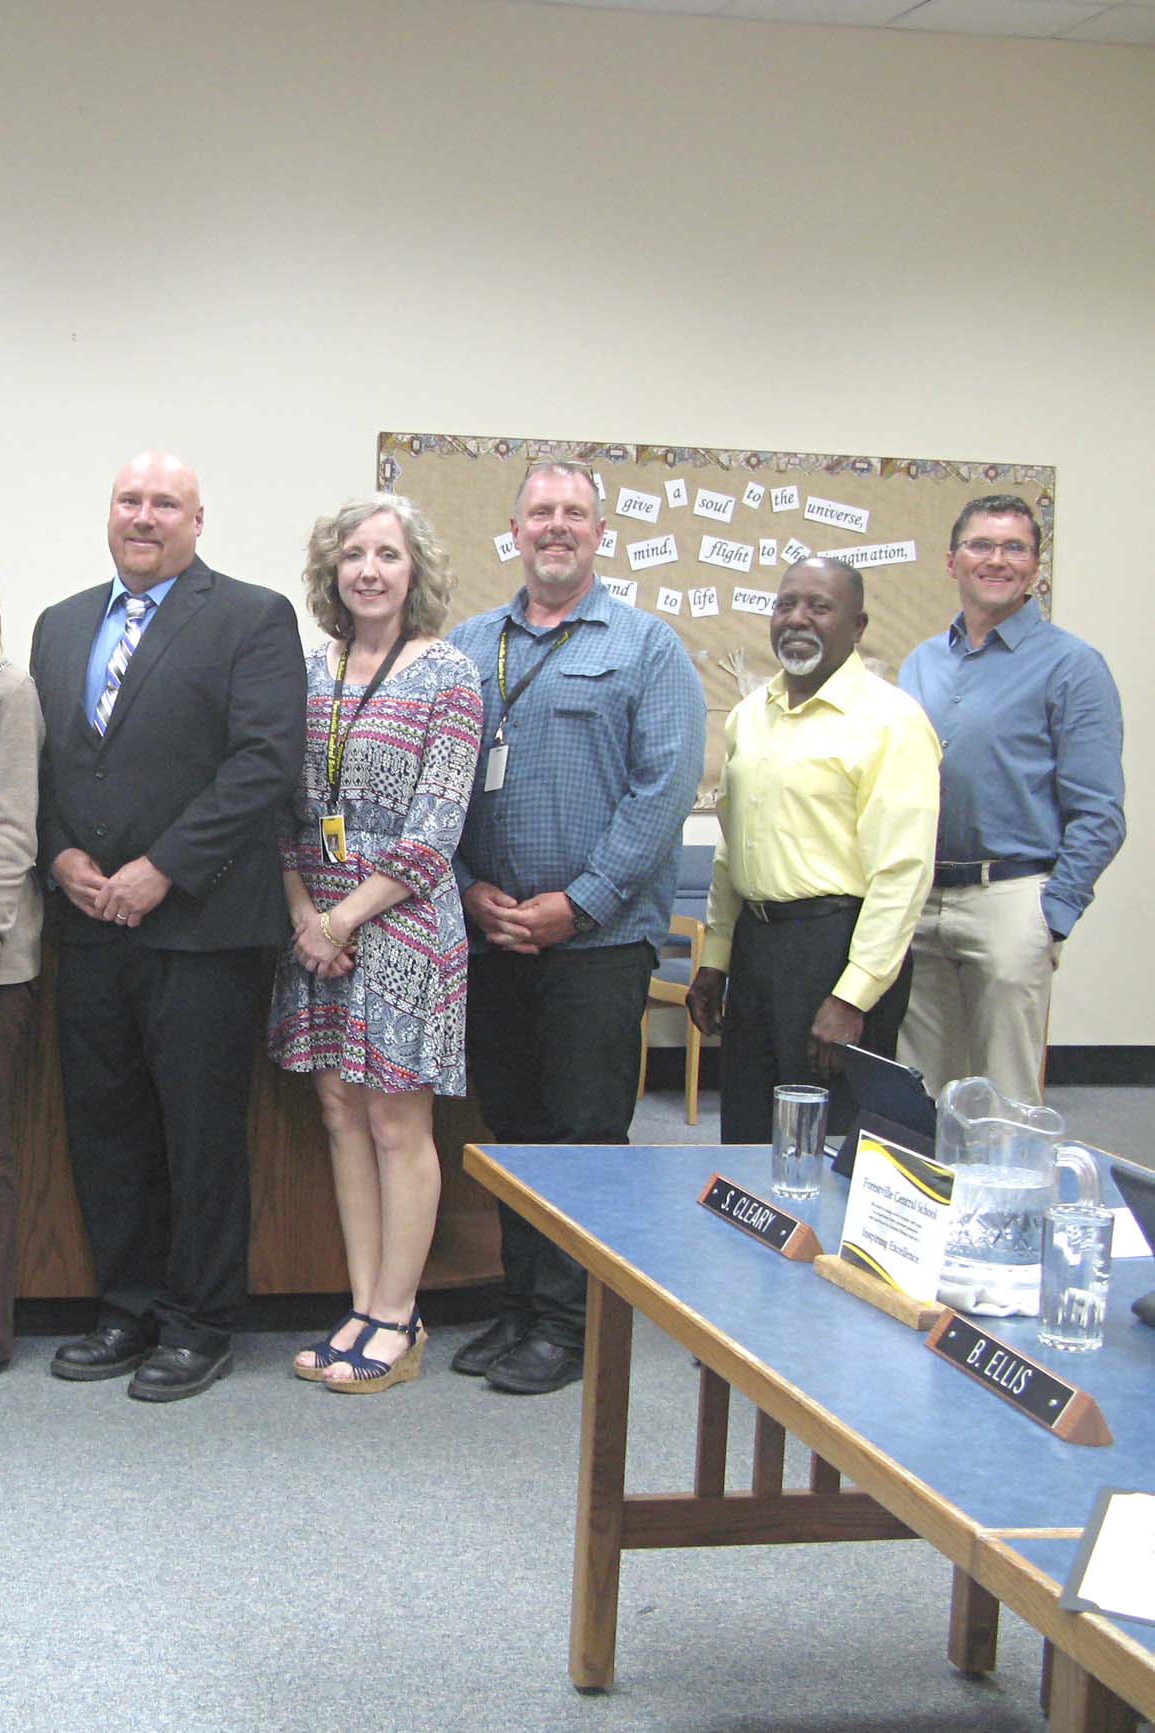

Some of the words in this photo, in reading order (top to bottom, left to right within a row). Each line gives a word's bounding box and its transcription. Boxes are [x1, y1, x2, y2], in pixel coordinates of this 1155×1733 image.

[621, 496, 654, 514] give
[673, 487, 682, 499] a
[698, 497, 732, 515] soul
[746, 487, 762, 502] to
[774, 488, 795, 506] the
[807, 502, 864, 528] universe,
[633, 537, 672, 562] mind,
[705, 541, 749, 564] flight
[761, 545, 775, 557] to
[785, 544, 805, 561] the
[663, 593, 677, 607] to
[692, 589, 715, 610] life
[721, 1190, 735, 1211] S.
[732, 1197, 777, 1233] CLEARY
[917, 1200, 938, 1220] School
[966, 1339, 986, 1367] B.
[984, 1350, 1032, 1394] ELLIS
